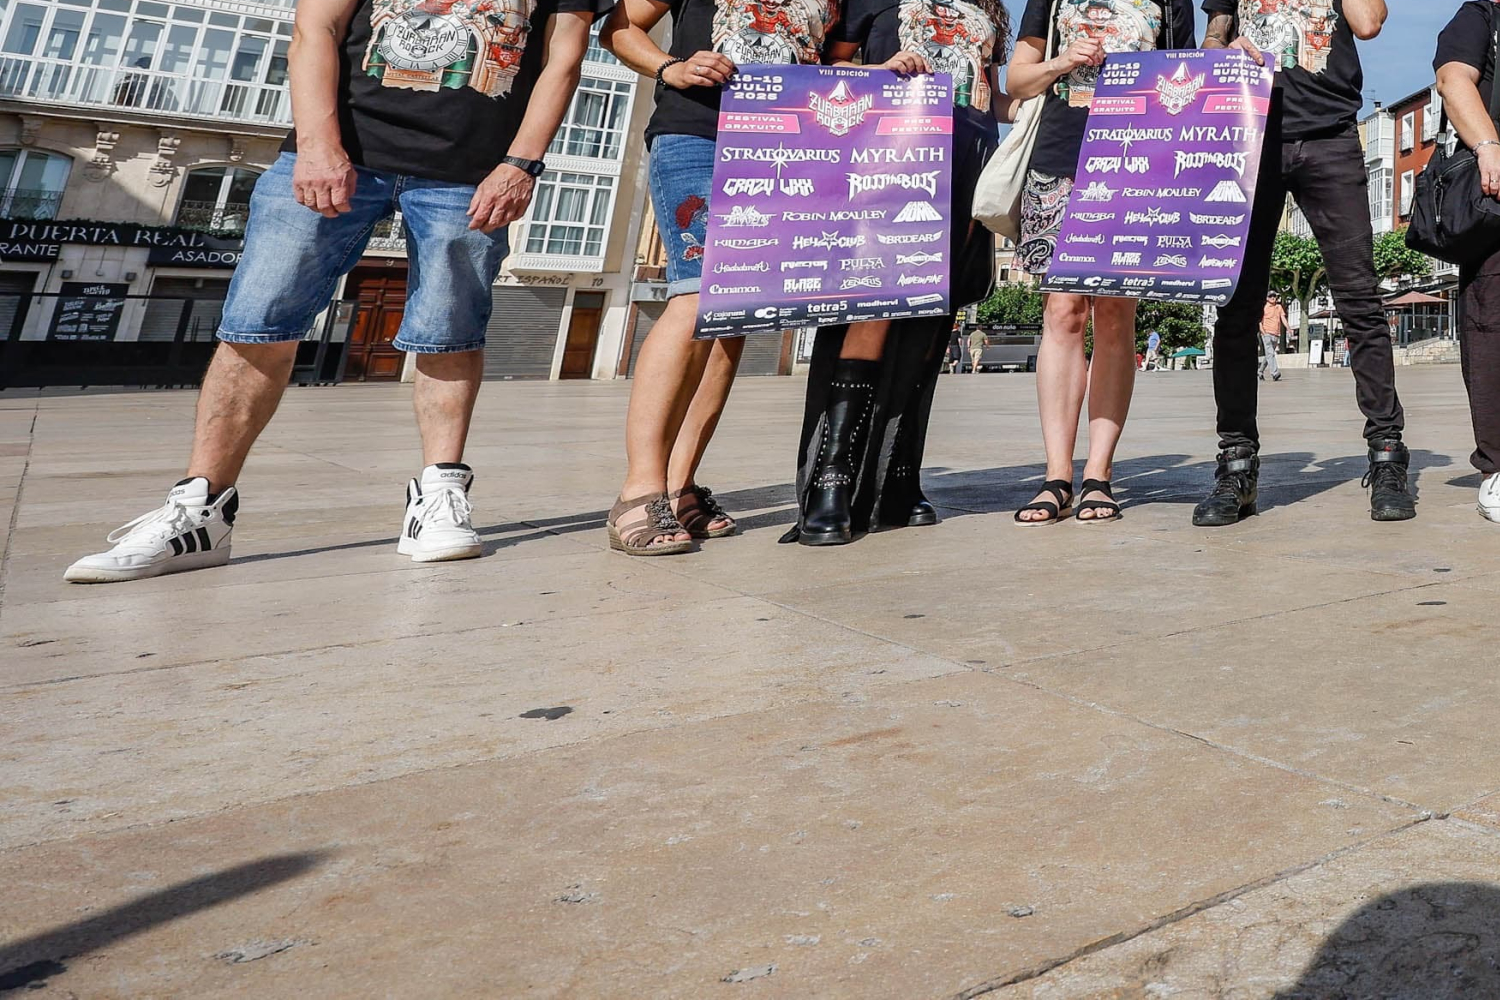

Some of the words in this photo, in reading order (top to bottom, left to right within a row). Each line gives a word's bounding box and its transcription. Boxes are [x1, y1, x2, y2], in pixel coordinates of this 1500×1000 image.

[1179, 51, 1205, 59] EDICIÓN
[1226, 54, 1255, 62] PARQU
[836, 68, 870, 77] EDICIÓN
[1218, 76, 1260, 86] SPAIN
[729, 83, 784, 92] JULIO
[891, 98, 939, 106] SPAIN
[724, 123, 785, 131] GRATUITO
[1086, 126, 1173, 146] STRATOVARIUS
[1179, 125, 1258, 143] MYRATH
[720, 144, 840, 168] STRATOVARIUS
[849, 147, 944, 163] MYRATH
[1085, 156, 1122, 174] CRAZY
[722, 178, 775, 197] CRAZY
[780, 178, 815, 197] LIXX
[1121, 187, 1155, 197] ROBIN
[782, 211, 827, 221] ROBIN
[9, 223, 119, 244] PUERTA
[133, 229, 205, 247] REAL
[1156, 235, 1193, 247] PULSA
[838, 256, 886, 269] PULSA
[516, 274, 570, 286] ESPAÑOL
[1123, 277, 1156, 287] tetra5
[807, 300, 848, 313] tetra5
